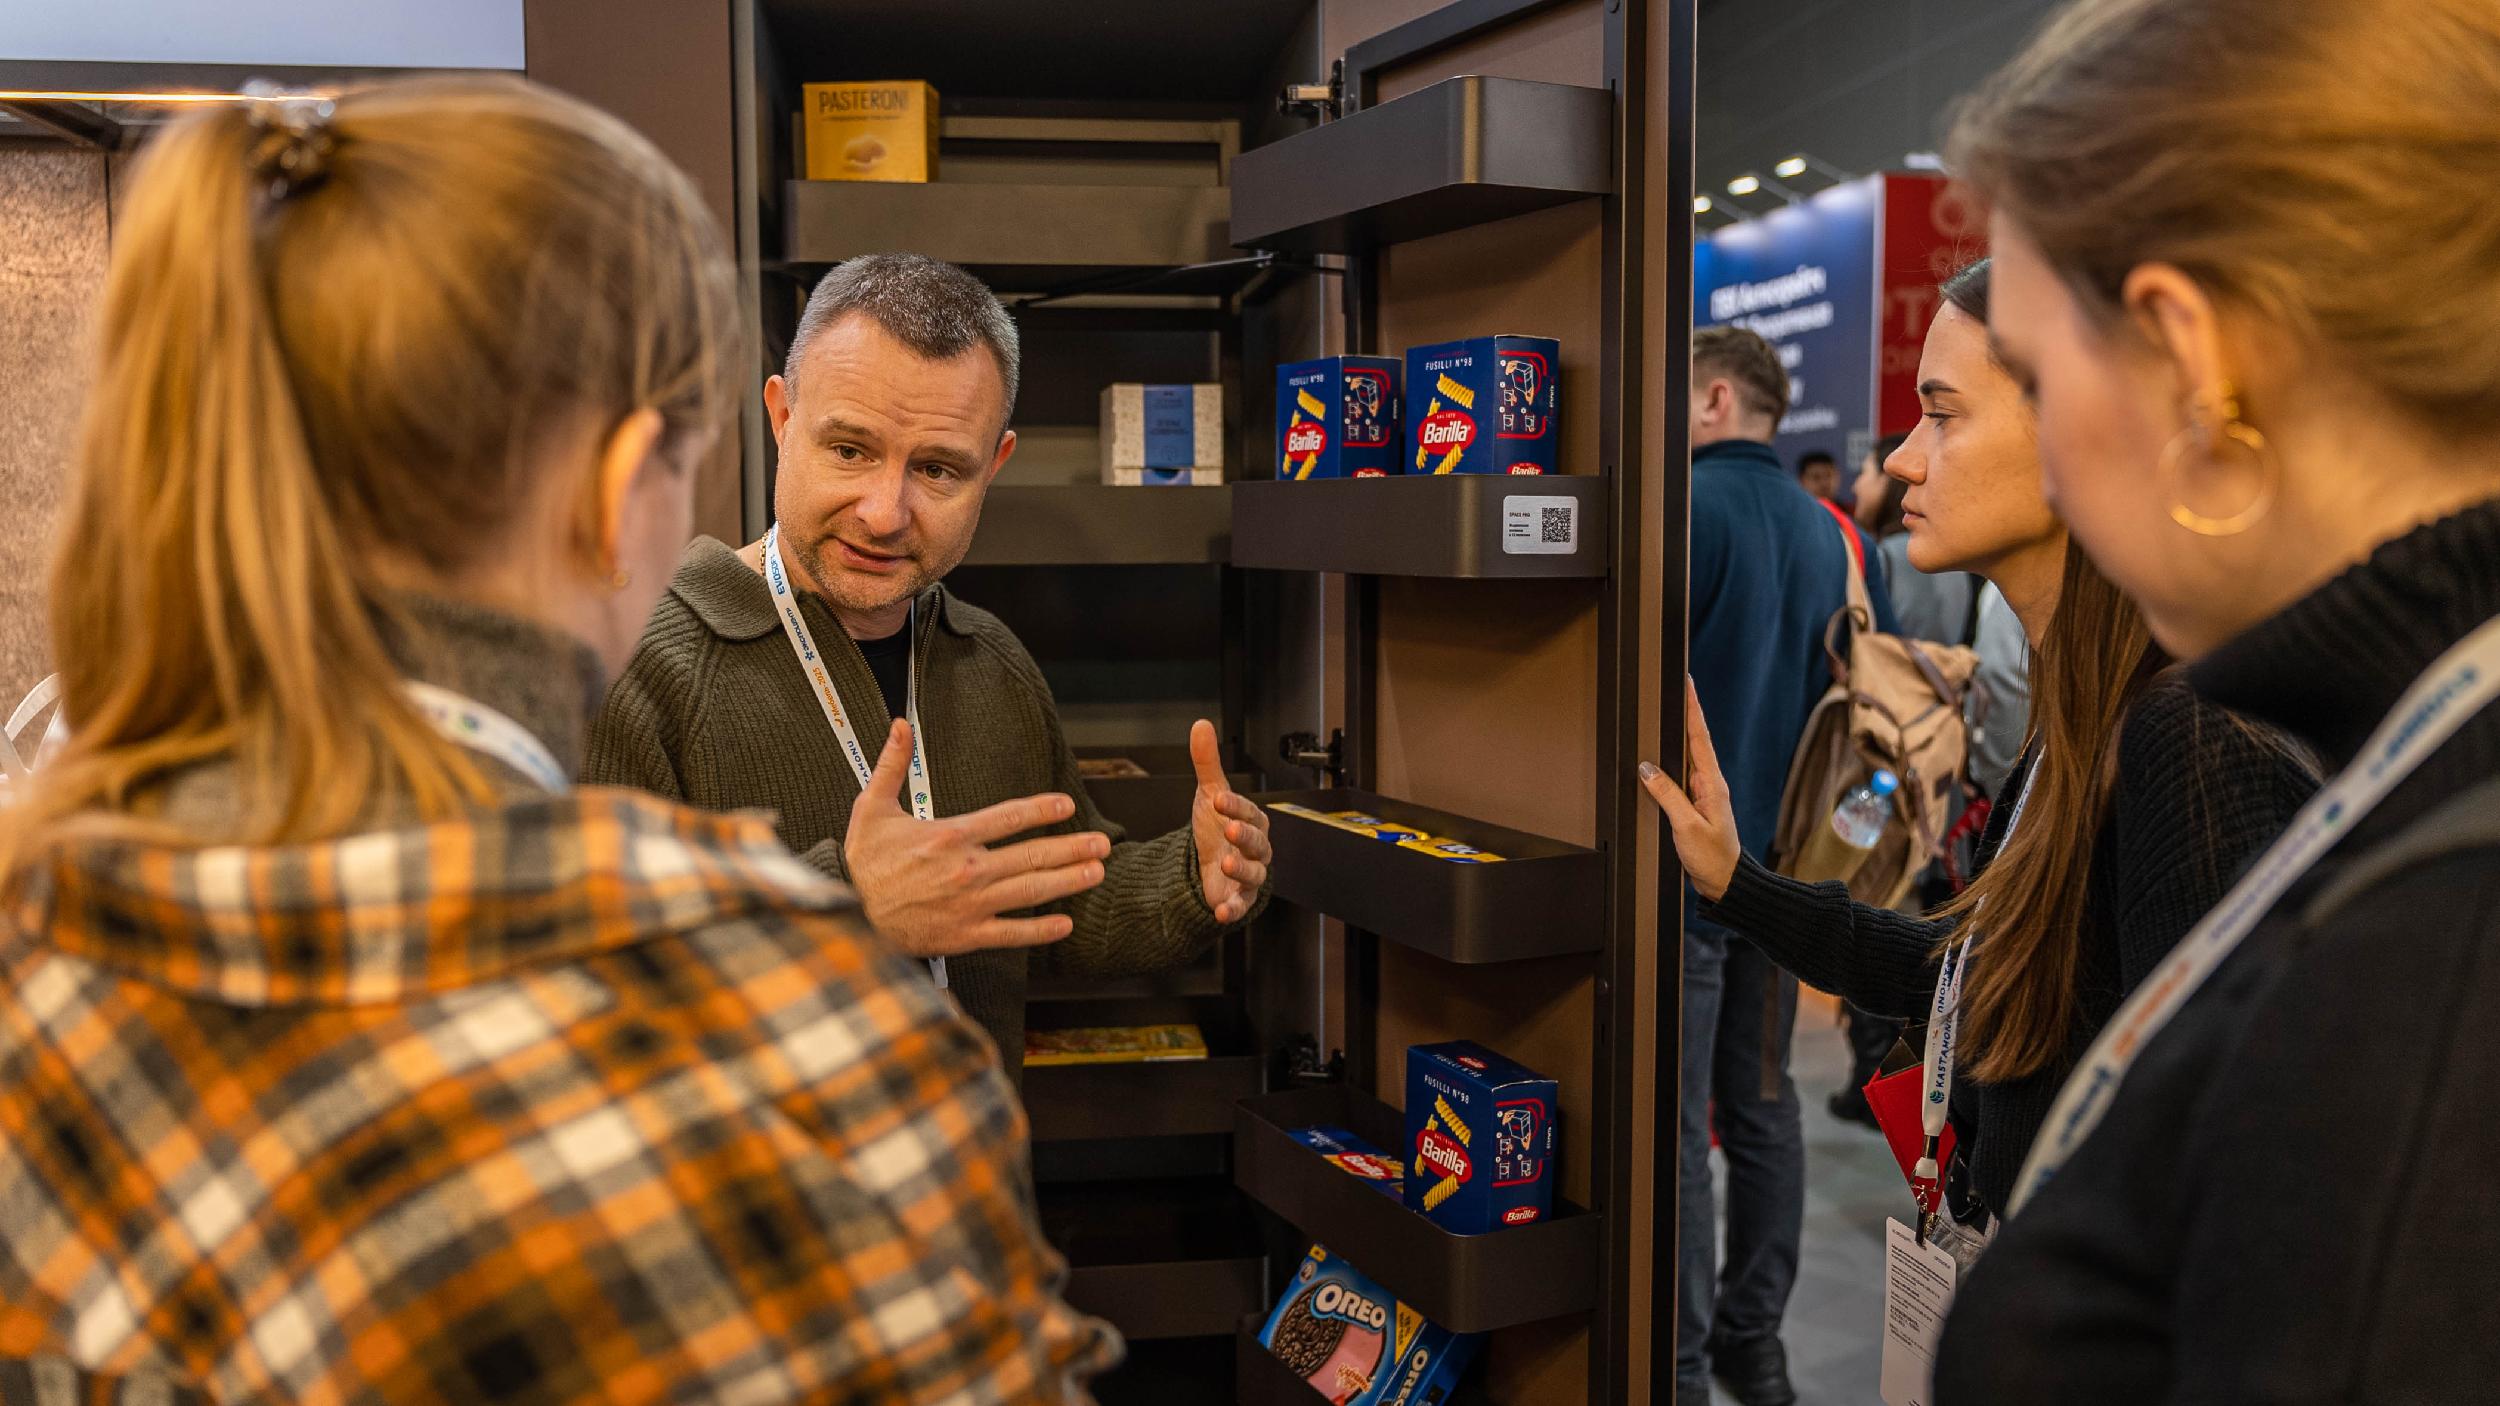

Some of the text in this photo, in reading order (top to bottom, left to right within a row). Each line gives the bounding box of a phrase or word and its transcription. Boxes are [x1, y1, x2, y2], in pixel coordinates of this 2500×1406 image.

[1425, 360, 1452, 371] FUSILLI
[1288, 430, 1322, 452] Barilla
[1424, 420, 1468, 444] Barilla
[847, 740, 870, 785] TAMONU
[1424, 1074, 1450, 1094] FUSILLI
[1422, 1136, 1465, 1176] Barilla
[1506, 1209, 1537, 1222] Barilla
[1315, 1283, 1387, 1329] OREO
